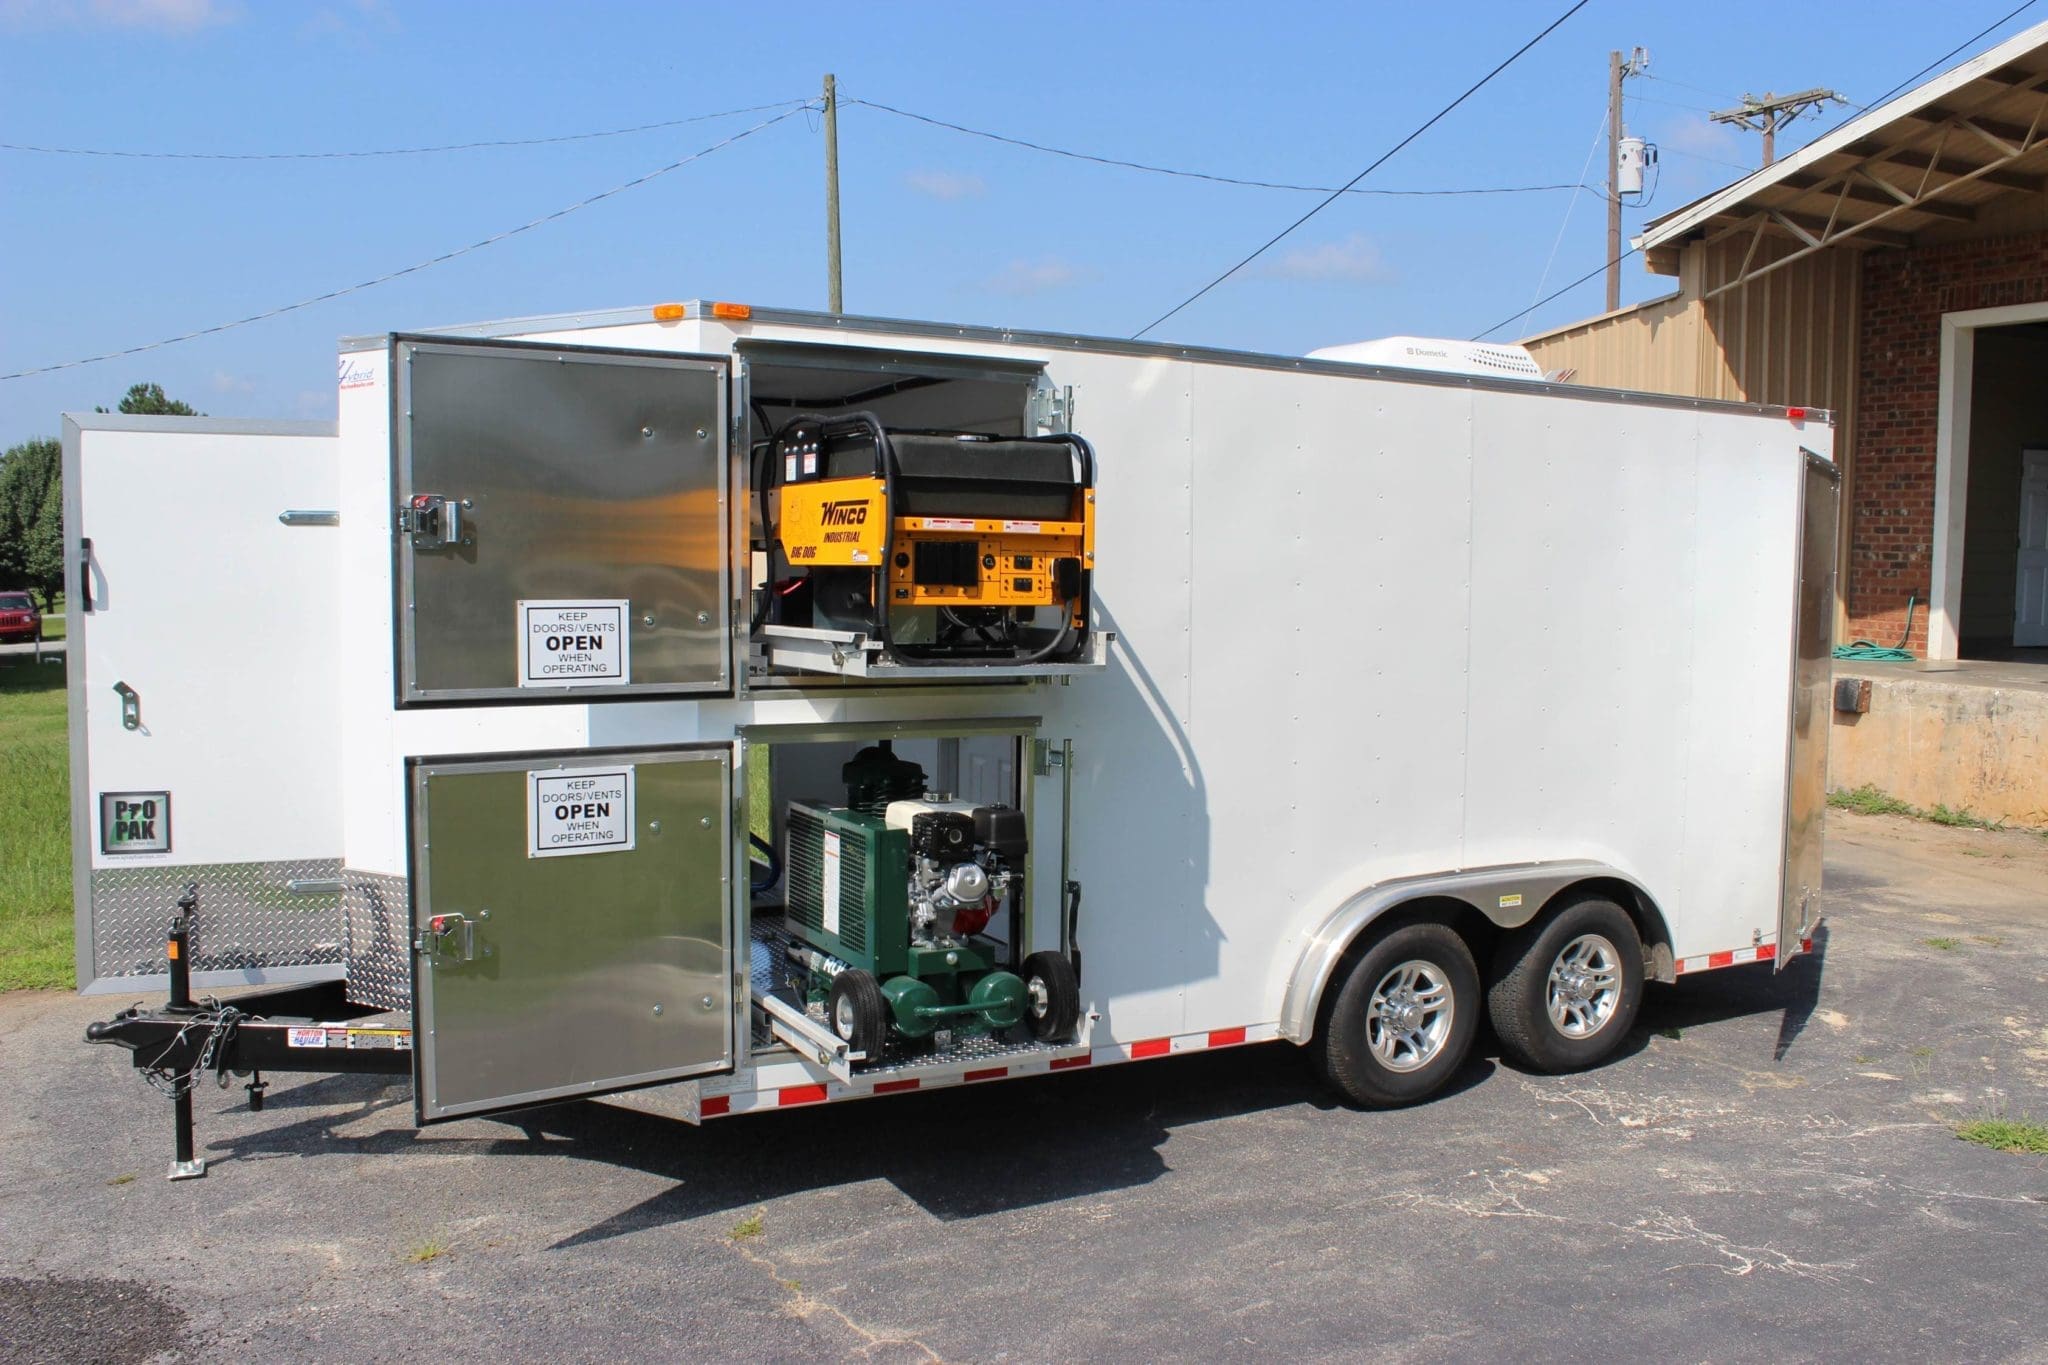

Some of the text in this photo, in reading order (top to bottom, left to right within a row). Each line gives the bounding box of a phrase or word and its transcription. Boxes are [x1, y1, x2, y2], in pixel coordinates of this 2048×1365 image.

[821, 499, 869, 526] WINCO
[823, 531, 860, 544] INDUSTRIAL
[790, 546, 817, 559] BIG DOG
[558, 612, 588, 621] KEEP
[533, 623, 615, 633] DOORS/VENTS
[546, 635, 603, 651] OPEN
[558, 653, 592, 662] WHEN
[542, 663, 608, 674] OPERATING
[567, 780, 596, 790] KEEP
[542, 790, 622, 803] DOORS/VENTS
[555, 802, 610, 820] OPEN
[115, 820, 156, 841] PAK
[566, 821, 600, 831] WHEN
[551, 830, 614, 843] OPERATING
